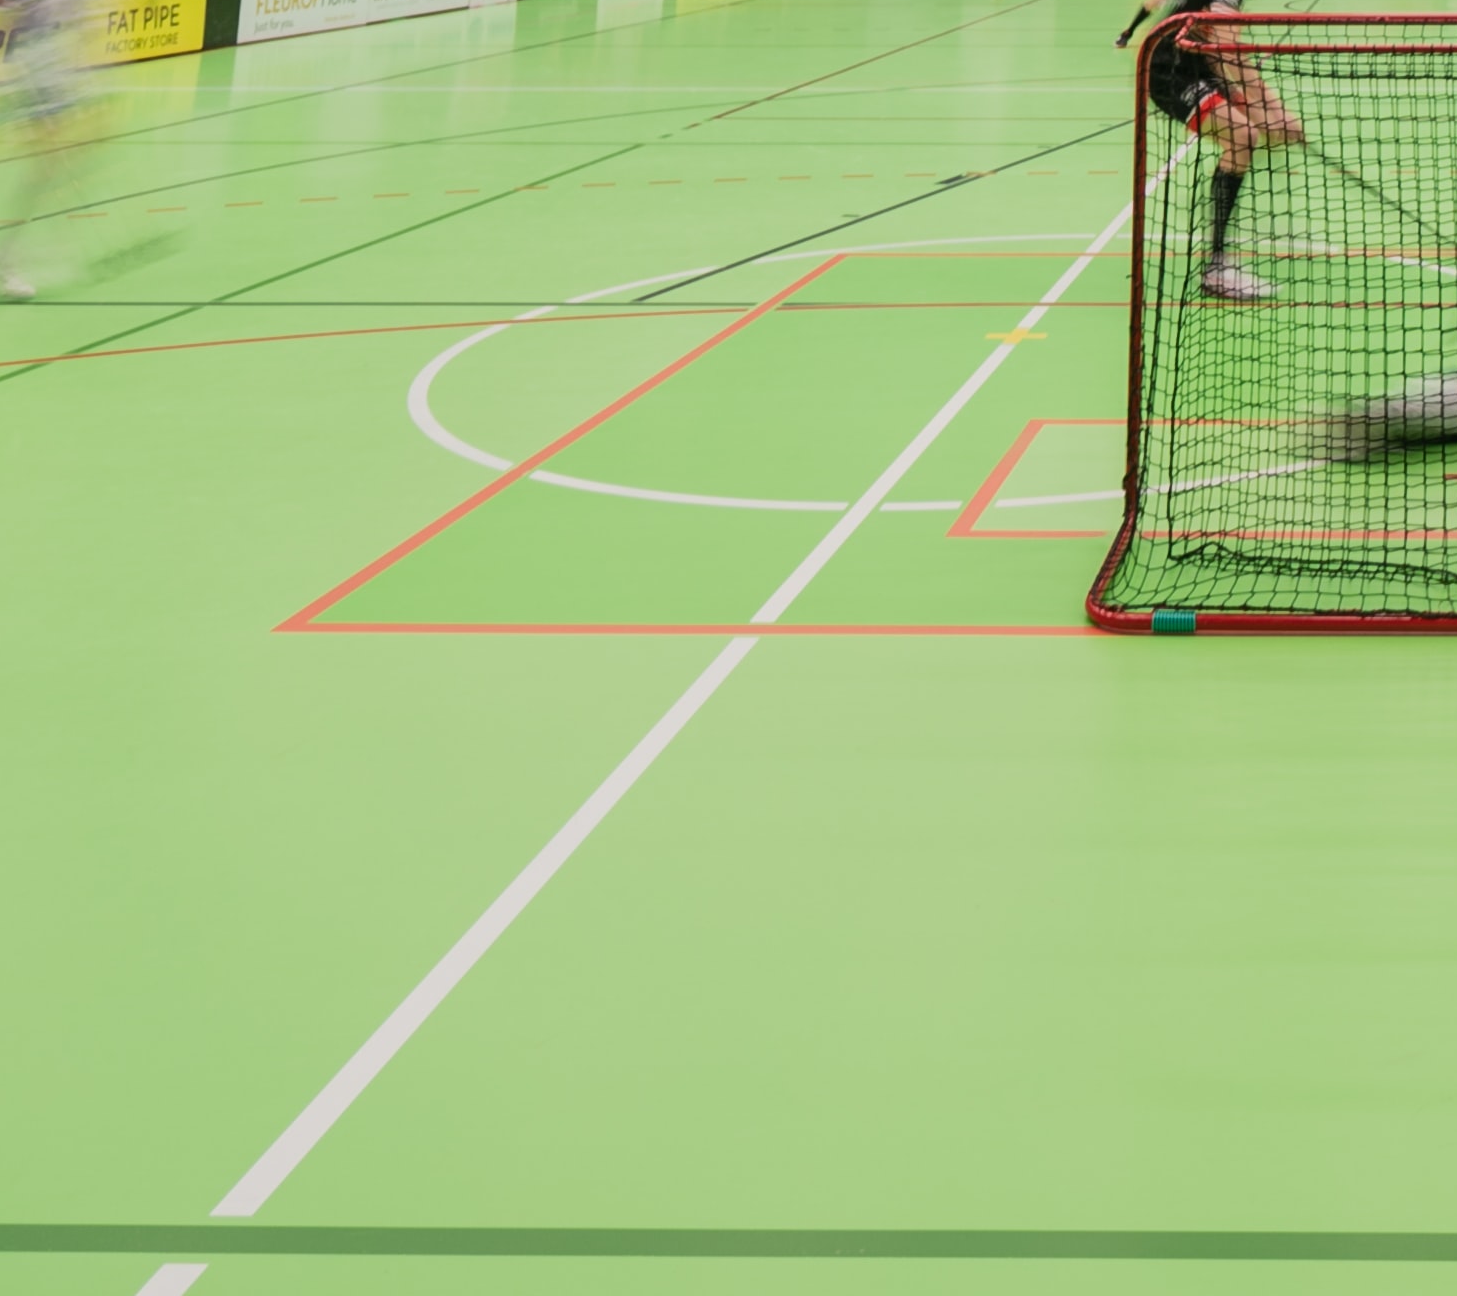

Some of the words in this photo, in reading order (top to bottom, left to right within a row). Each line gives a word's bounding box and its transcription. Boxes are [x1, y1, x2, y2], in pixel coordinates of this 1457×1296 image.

[107, 9, 137, 35] FAT
[143, 3, 180, 30] PIPE
[105, 36, 149, 54] FACTORY
[149, 32, 179, 49] STORE
